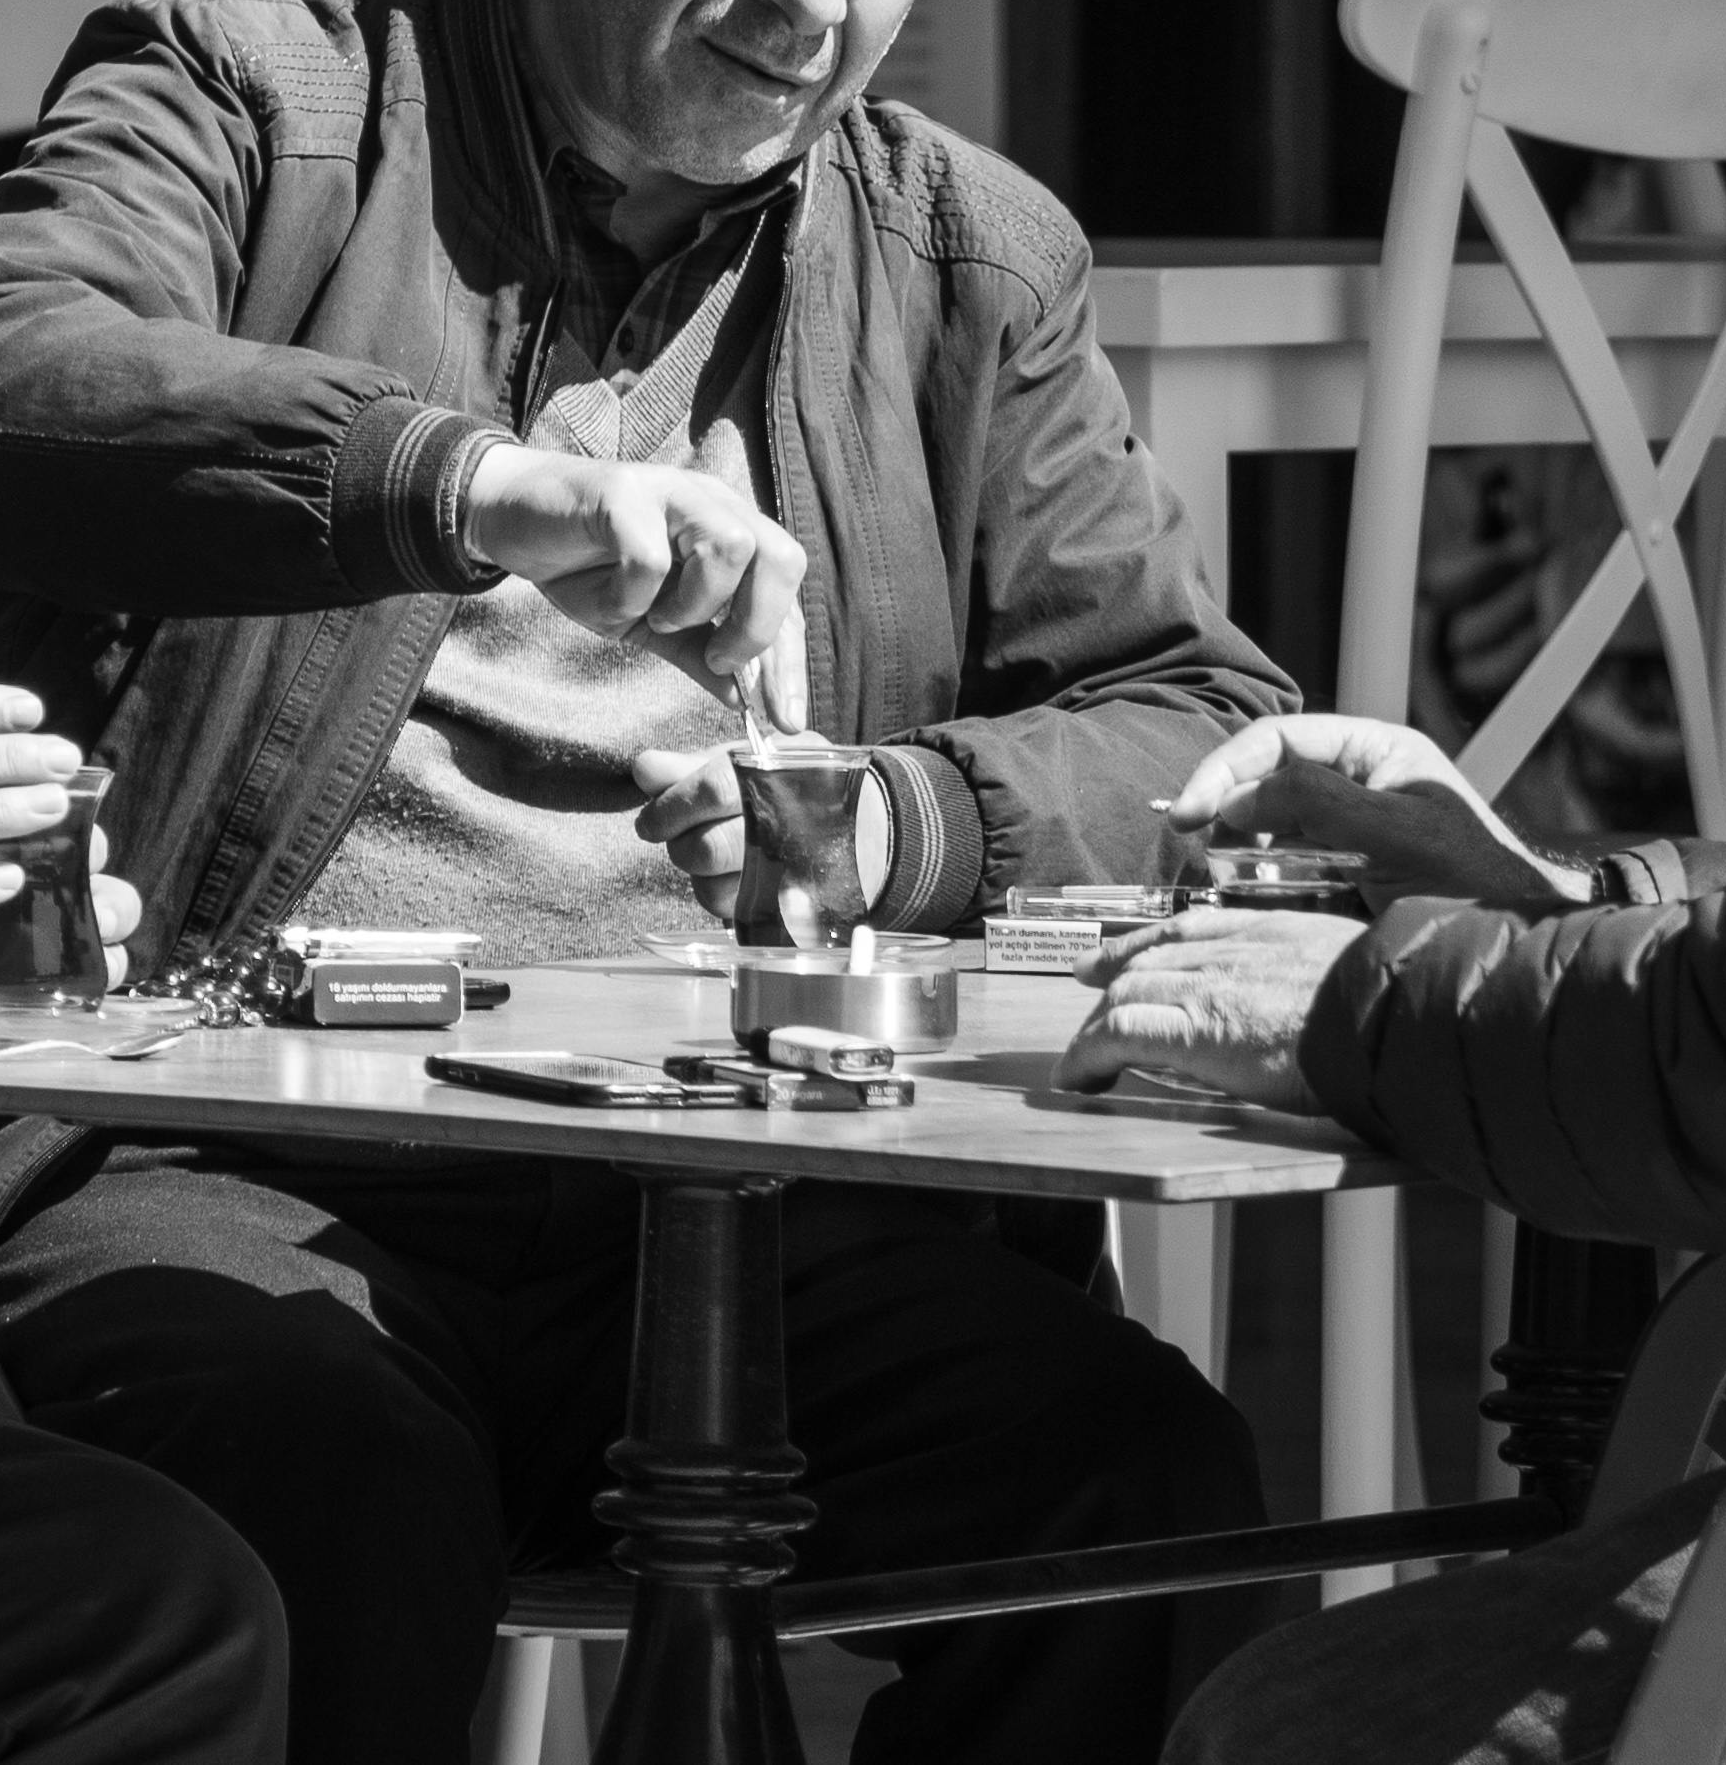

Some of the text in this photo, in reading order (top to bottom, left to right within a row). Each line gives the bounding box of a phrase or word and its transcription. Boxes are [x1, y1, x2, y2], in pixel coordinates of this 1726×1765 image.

[1059, 930, 1098, 939] kansere
[989, 941, 1003, 950] yol
[1005, 941, 1032, 952] açtığı
[1034, 941, 1066, 951] bilinen
[1001, 953, 1023, 962] fazla
[1025, 953, 1058, 963] madde
[328, 982, 448, 994] 18 yaşını doldurmayanlara
[334, 993, 374, 1004] satışının
[375, 993, 406, 1003] cezası
[775, 1087, 789, 1101] 20
